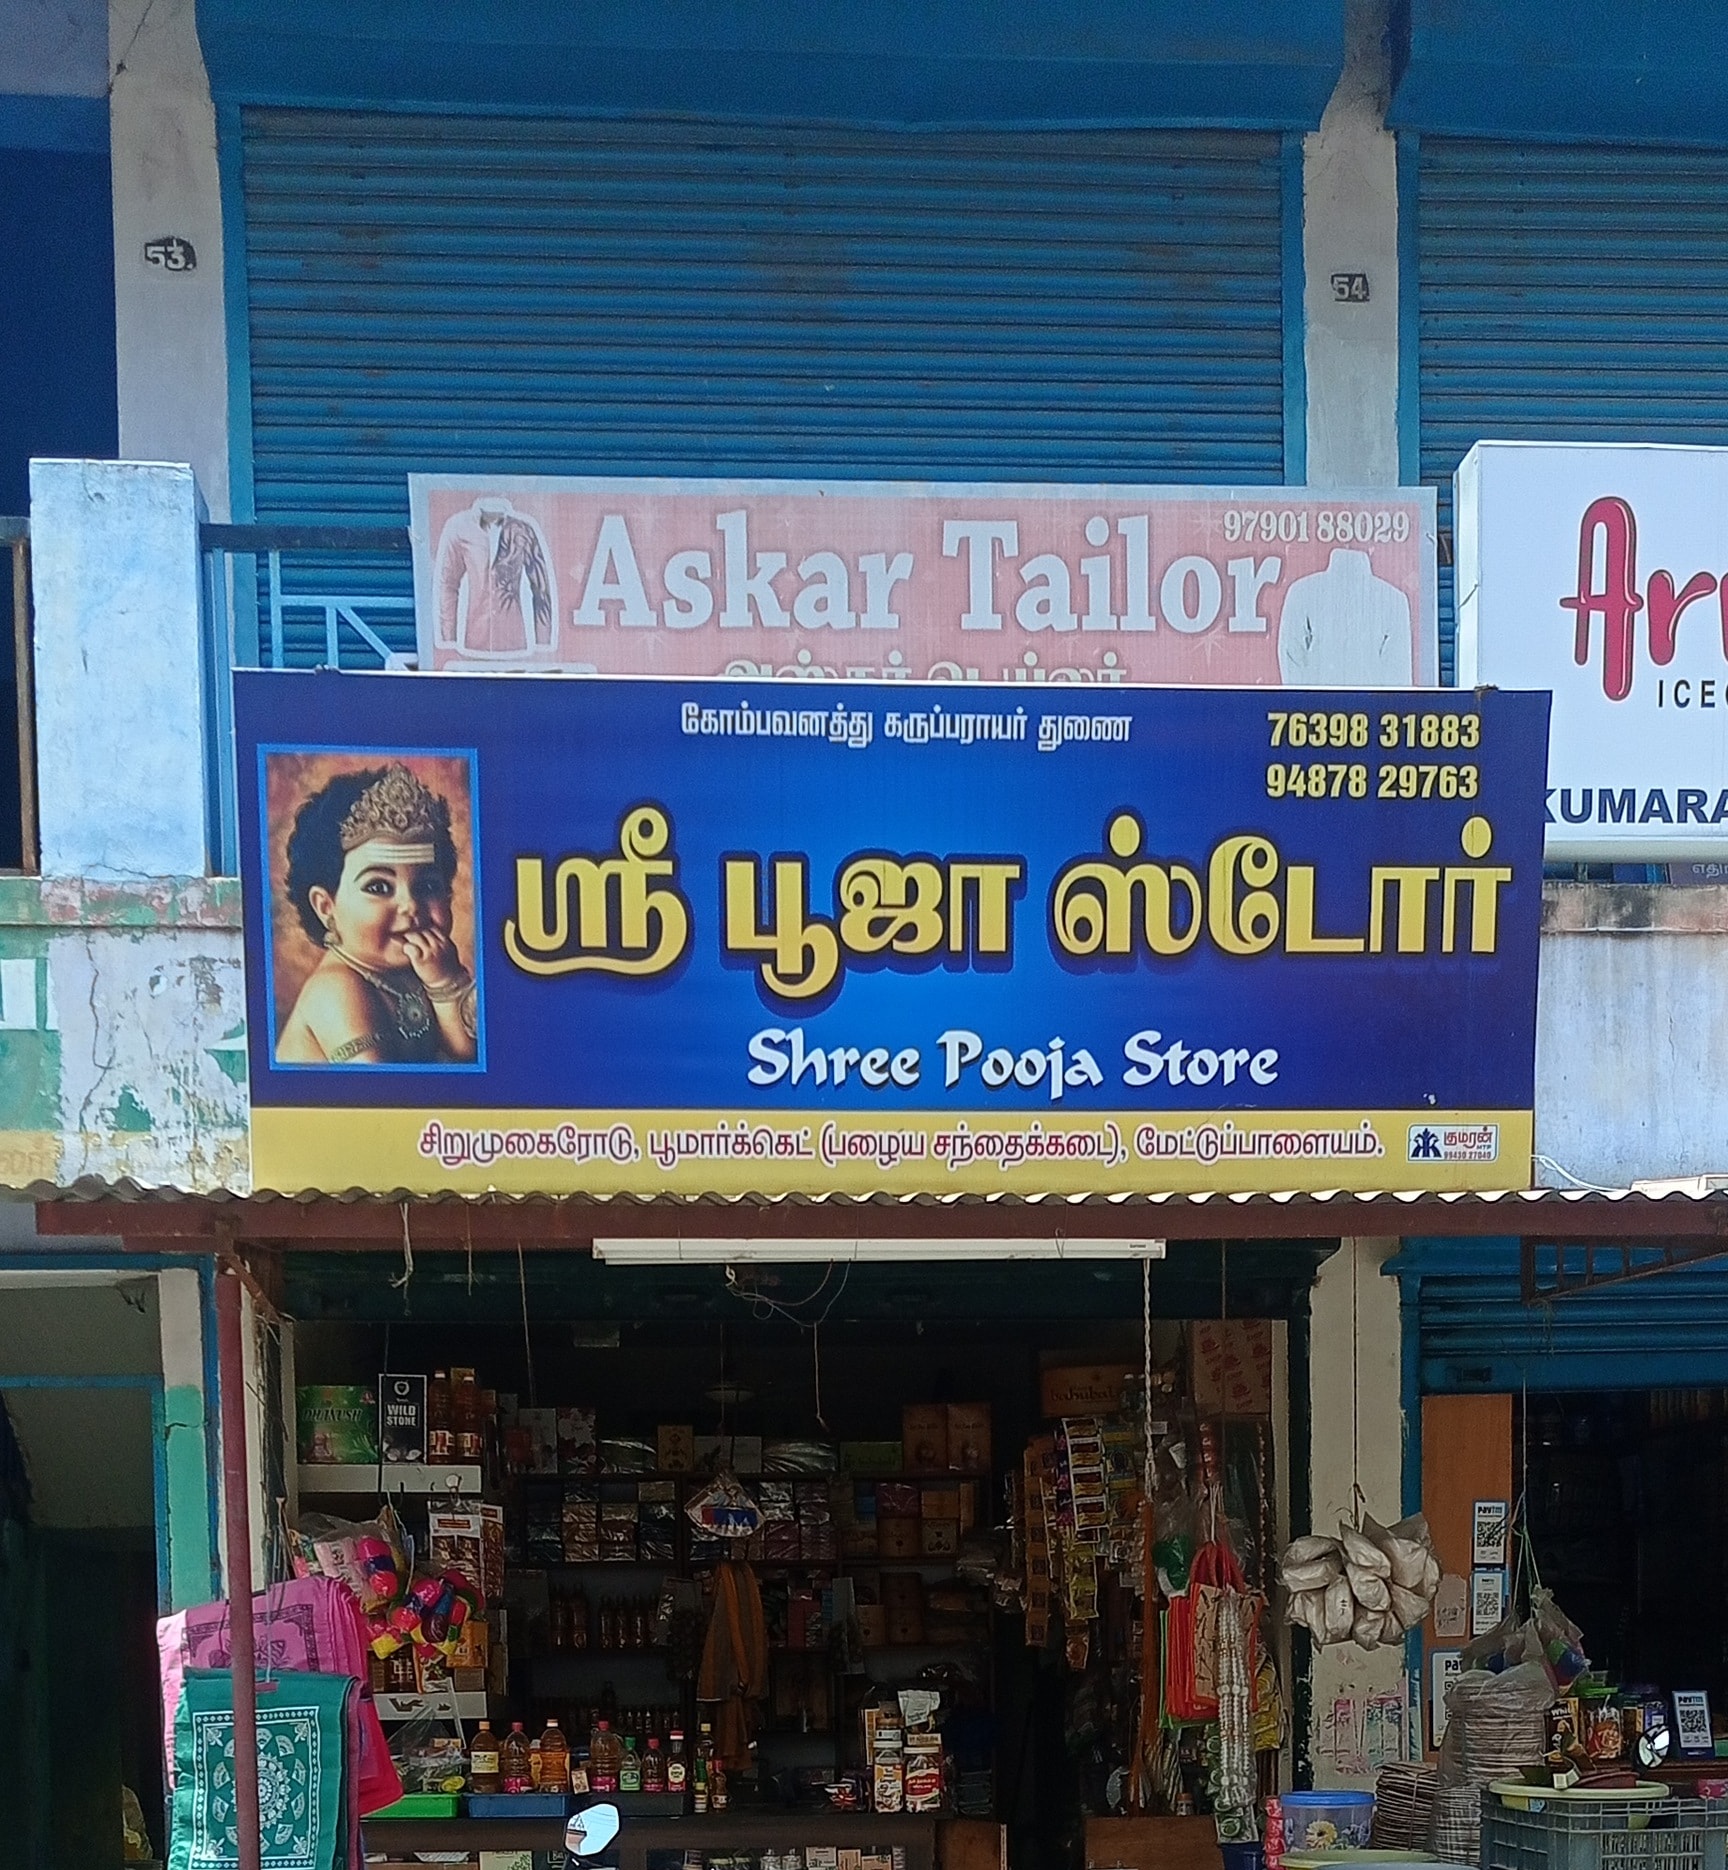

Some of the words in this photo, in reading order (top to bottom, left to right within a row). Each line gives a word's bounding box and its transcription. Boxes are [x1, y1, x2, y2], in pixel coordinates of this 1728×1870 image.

[1331, 274, 1368, 301] 54
[1223, 510, 1310, 543] 97901
[1316, 510, 1409, 543] 88029
[573, 510, 914, 630] Askar
[942, 515, 1282, 633] Tailor
[1559, 496, 1728, 701] Ar
[1657, 679, 1728, 708] ICE
[884, 704, 1028, 745] கருப்பராயர்
[1038, 714, 1133, 751] துணை
[1267, 712, 1369, 747] 76398
[1379, 713, 1480, 748] 31883
[1266, 764, 1367, 798] 94878
[1377, 765, 1479, 799] 29763
[725, 858, 1021, 998] பூஜா
[1054, 814, 1512, 954] ஸ்டோர்
[747, 1026, 920, 1088] Shree
[936, 1029, 1103, 1100] Pooja
[1122, 1029, 1280, 1088] Store
[1444, 1126, 1493, 1149] குமரன்
[386, 1404, 416, 1416] WILD
[386, 1416, 417, 1426] STONE
